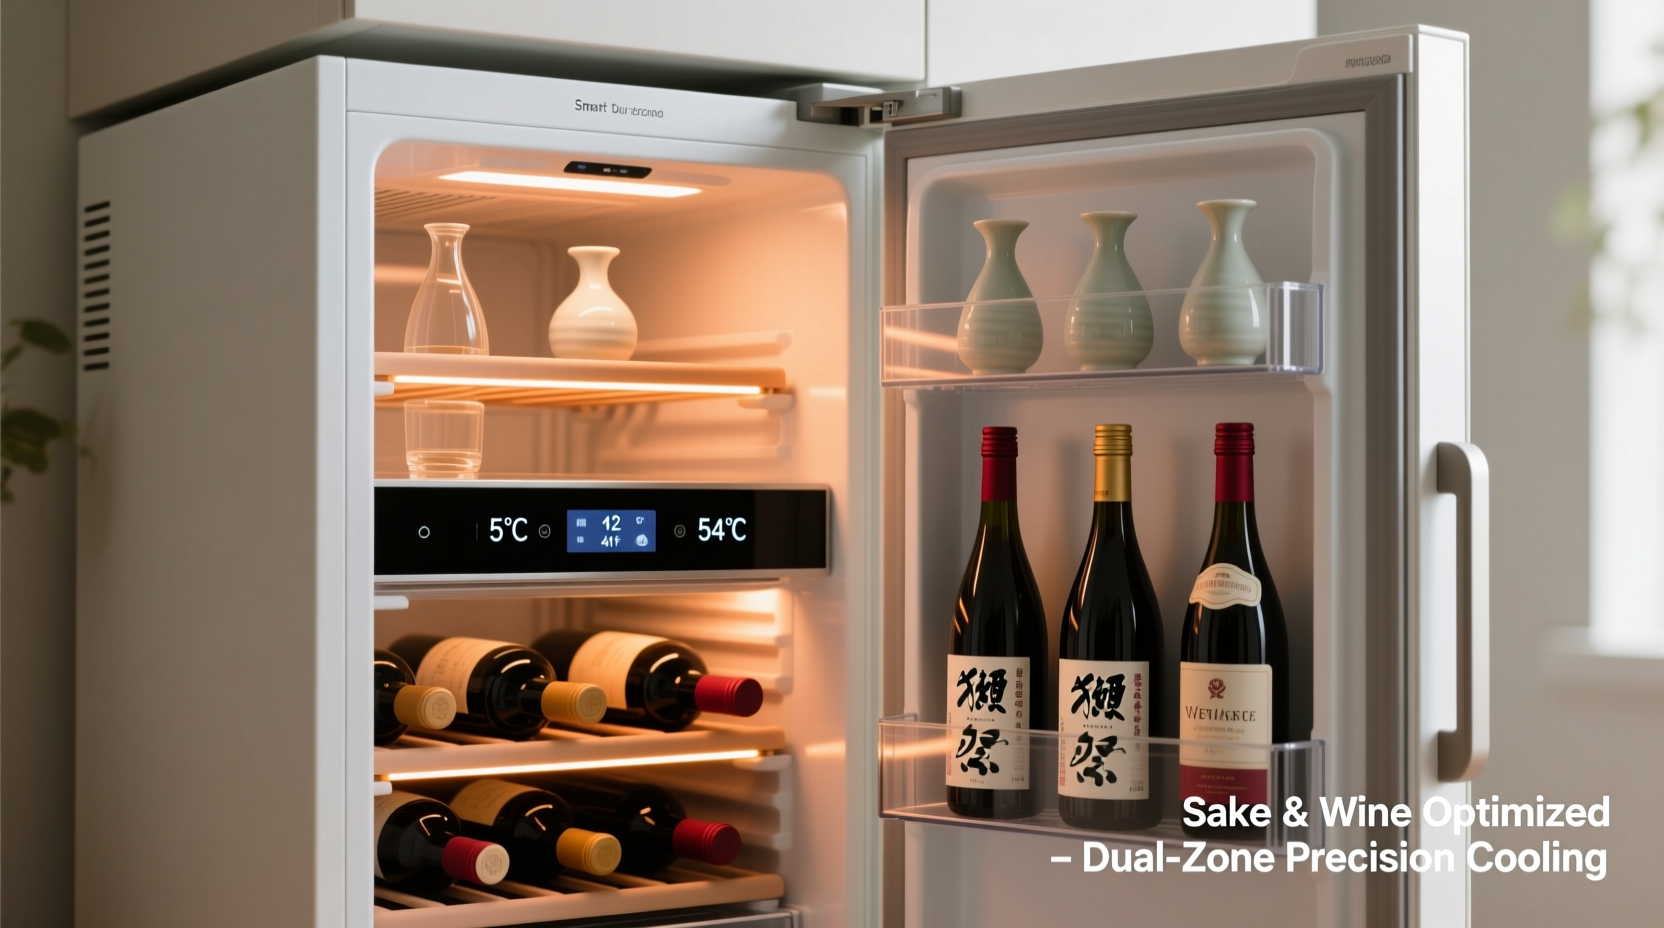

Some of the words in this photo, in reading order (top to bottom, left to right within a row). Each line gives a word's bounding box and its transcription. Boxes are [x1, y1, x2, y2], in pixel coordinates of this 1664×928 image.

[574, 98, 608, 113] Smart
[489, 516, 529, 543] 5°C
[602, 514, 622, 531] 12
[697, 516, 748, 542] 54°C
